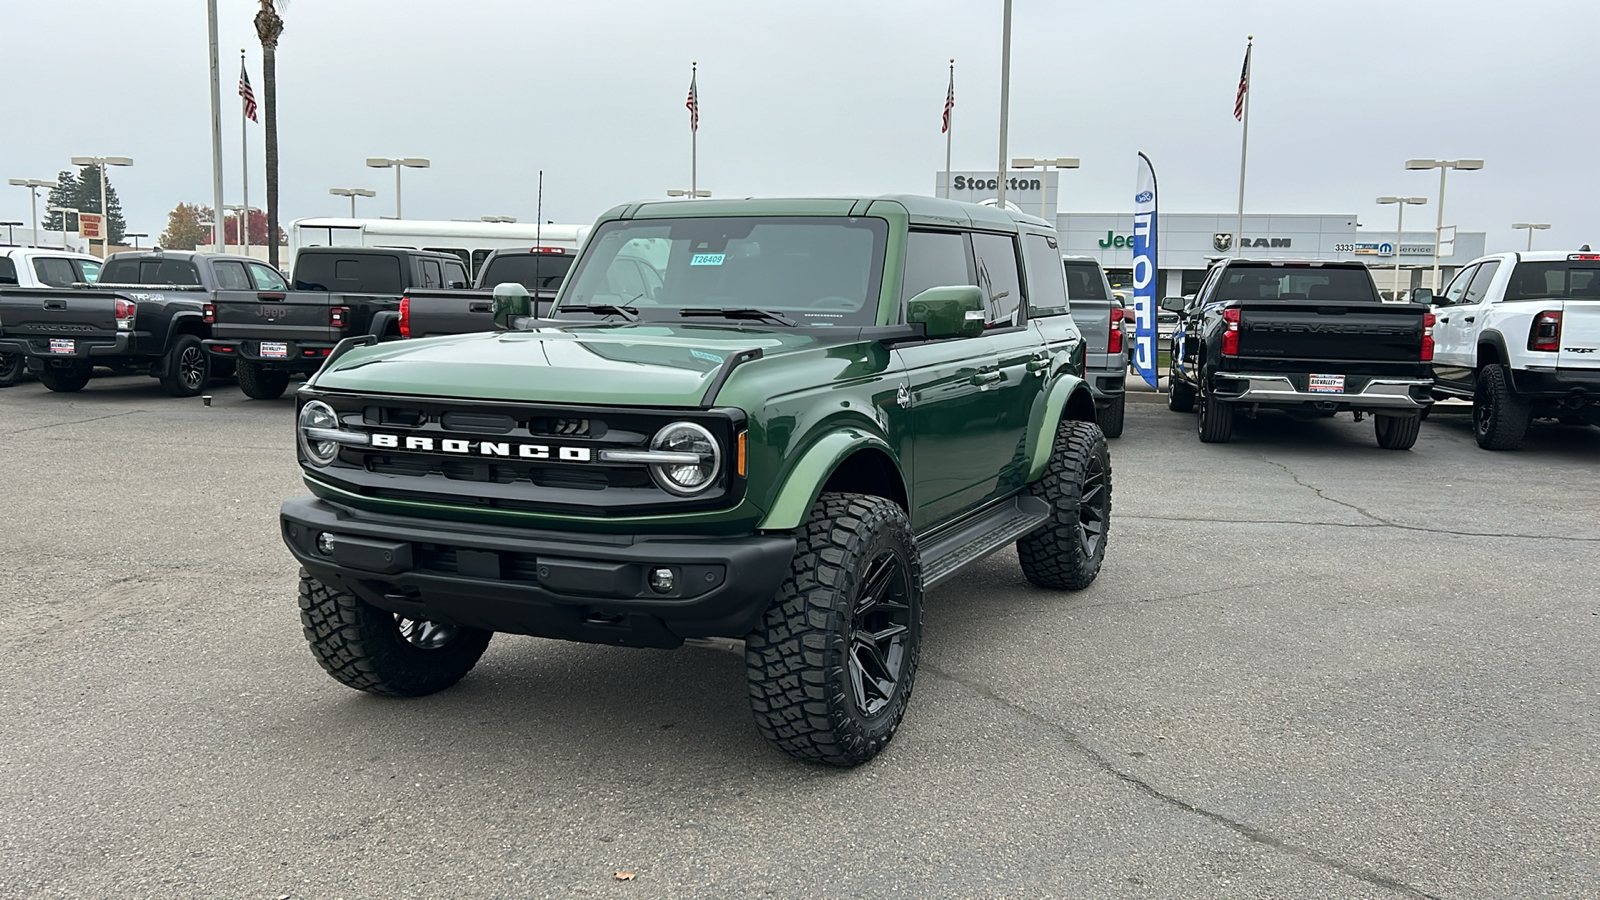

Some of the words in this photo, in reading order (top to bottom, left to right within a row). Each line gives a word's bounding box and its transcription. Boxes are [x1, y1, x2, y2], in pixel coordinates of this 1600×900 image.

[1098, 230, 1134, 248] Jee
[1236, 237, 1292, 248] RAM
[1335, 244, 1354, 252] 3333
[694, 255, 722, 264] T26409
[256, 305, 287, 319] Jeep
[27, 324, 94, 332] TACOMA
[1252, 322, 1413, 336] CHEVROLET
[372, 433, 591, 461] BRONCO
